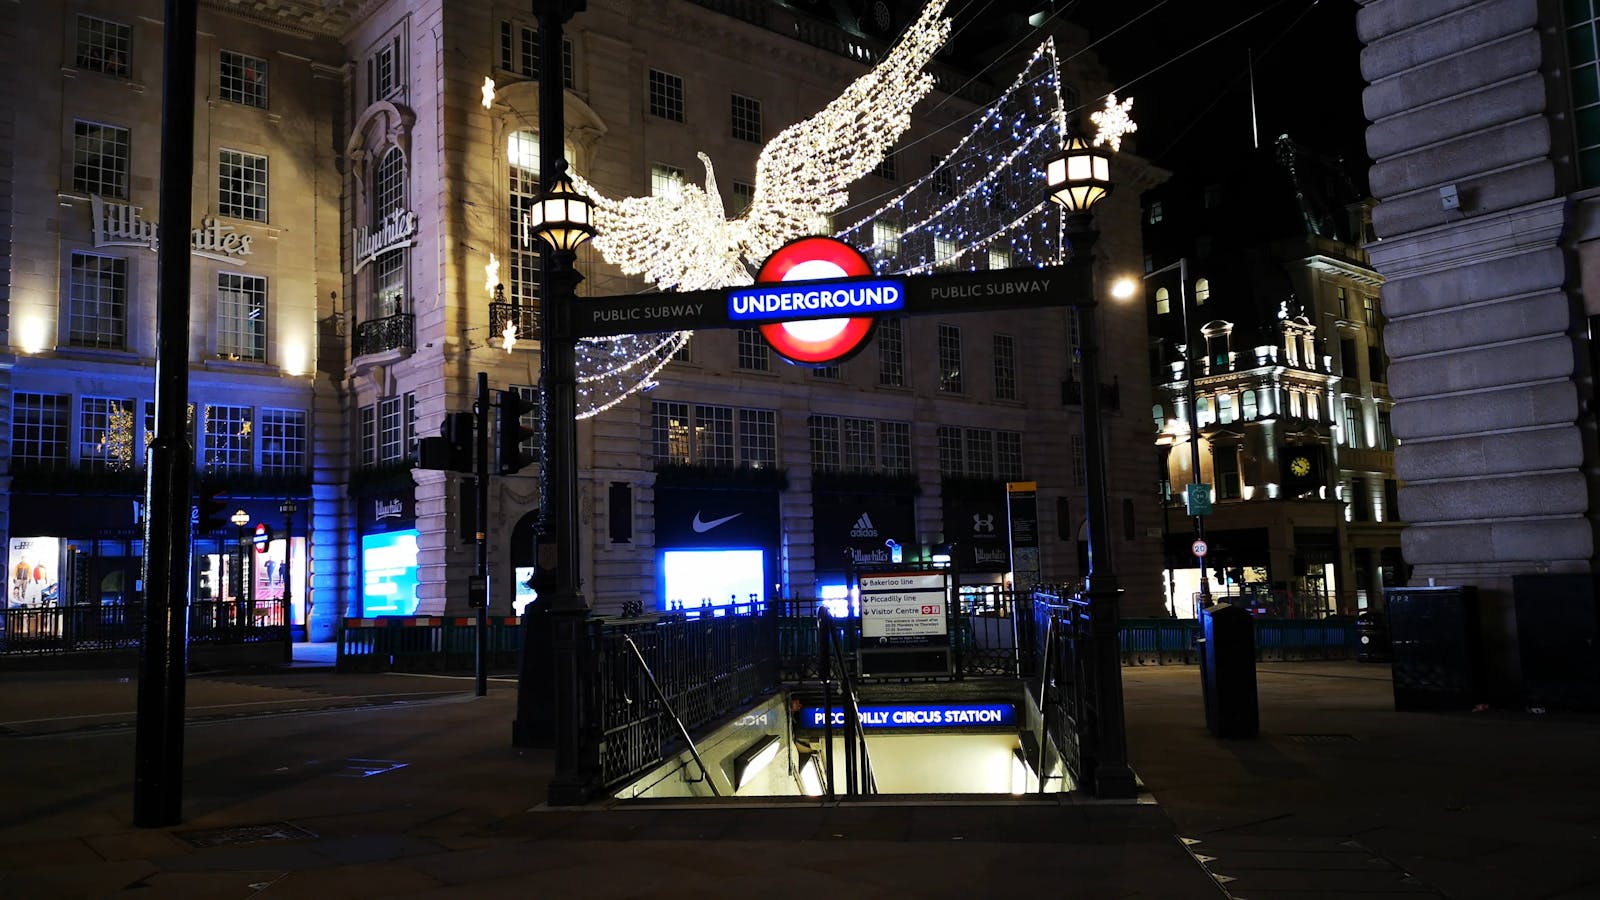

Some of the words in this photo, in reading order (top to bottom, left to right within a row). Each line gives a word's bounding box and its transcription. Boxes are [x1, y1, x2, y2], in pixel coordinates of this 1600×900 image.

[91, 193, 255, 260] Lillyites
[931, 284, 982, 300] PUBLIC
[986, 279, 1051, 296] SUBWAY
[732, 285, 899, 315] UNDERGROUND
[592, 308, 641, 323] PUBLIC
[644, 303, 704, 319] SUBWAY
[850, 529, 879, 538] adidas
[1195, 545, 1205, 553] 20
[870, 595, 902, 603] Piccadilly
[814, 711, 891, 725] PICDILLY
[891, 710, 941, 724] CIRCUS
[944, 709, 1001, 722] STATION
